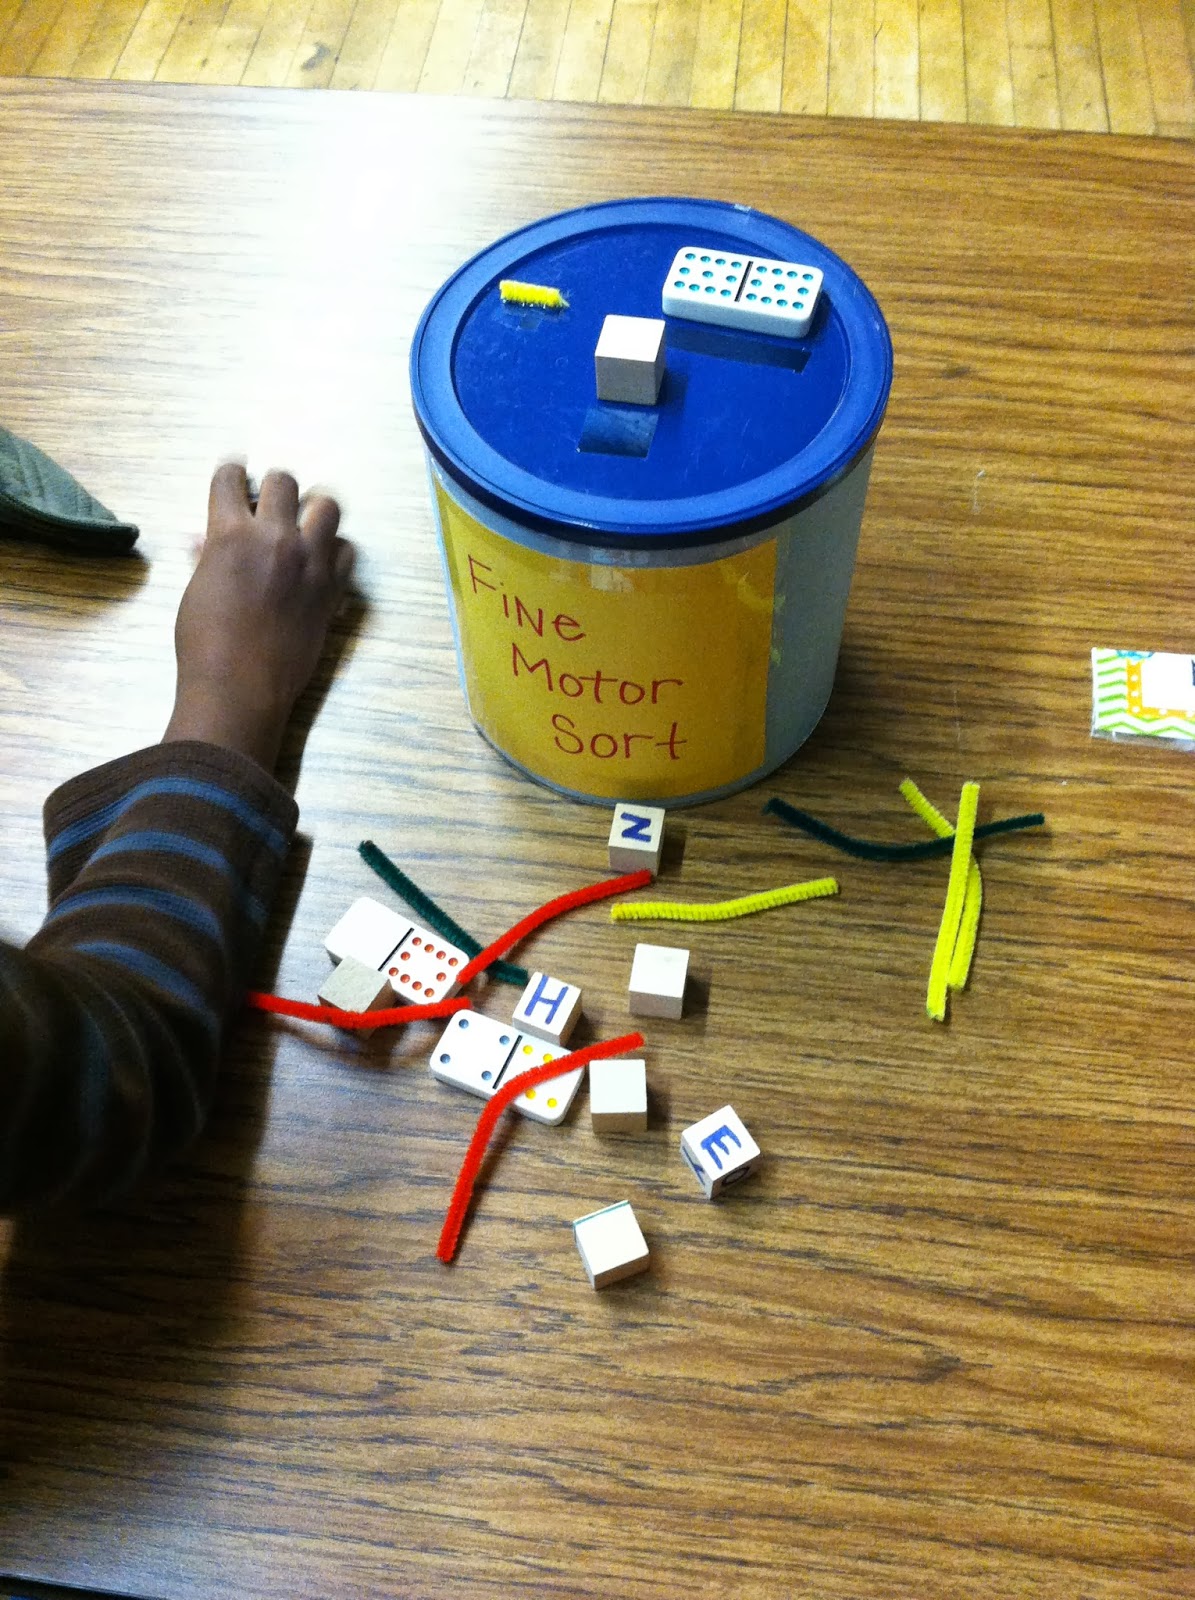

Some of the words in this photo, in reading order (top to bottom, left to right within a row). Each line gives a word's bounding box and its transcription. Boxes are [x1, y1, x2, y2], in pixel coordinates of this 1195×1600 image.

[511, 642, 684, 705] Motor
[551, 713, 688, 760] Sort
[523, 974, 569, 1025] H
[700, 1124, 742, 1170] E
